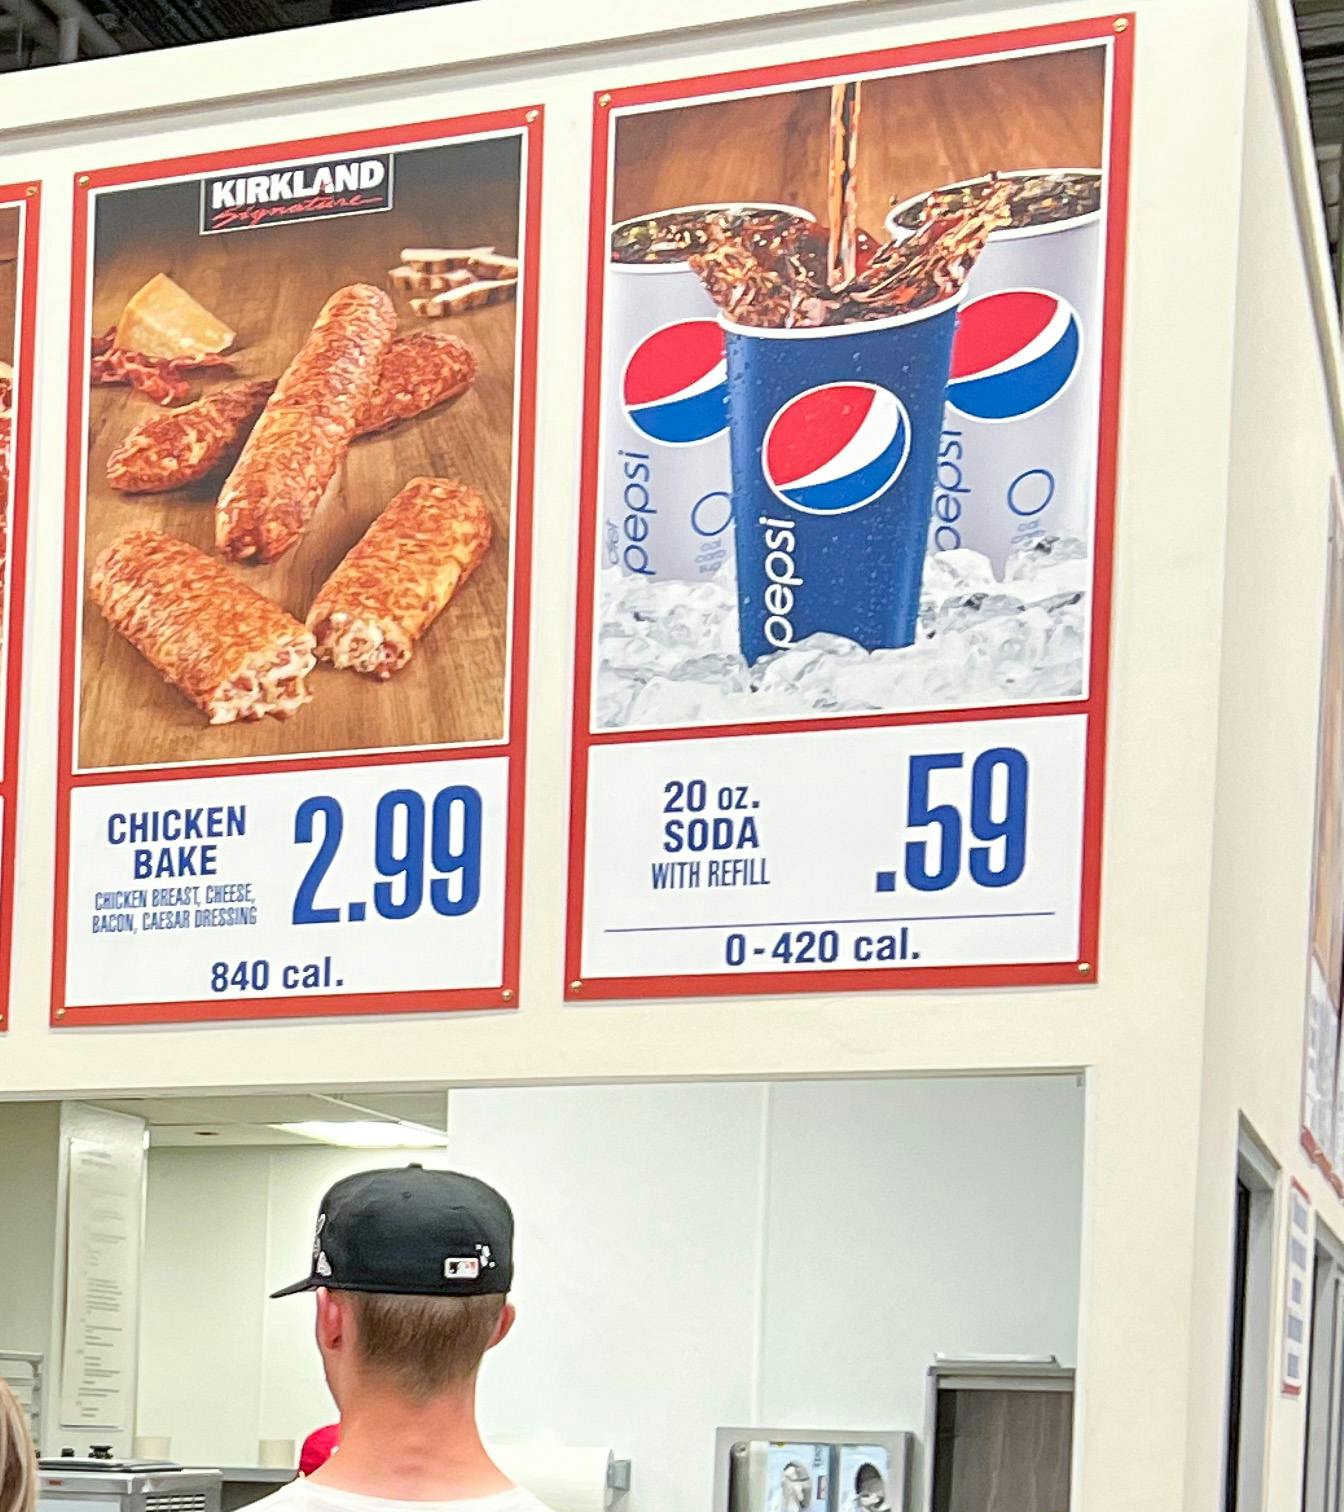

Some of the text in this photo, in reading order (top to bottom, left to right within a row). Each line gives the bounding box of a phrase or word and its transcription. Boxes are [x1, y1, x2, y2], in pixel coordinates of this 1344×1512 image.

[213, 160, 385, 209] KIRKLAND
[212, 194, 384, 229] Signature
[617, 449, 658, 575] pepsi
[760, 516, 803, 648] pepsi
[663, 779, 760, 813] 20 oz.
[107, 805, 247, 844] CHICKEN
[663, 816, 760, 852] SODA
[875, 747, 1029, 892] .59
[133, 844, 217, 879] BAKE
[291, 784, 483, 925] 2.99
[652, 858, 770, 889] WITH REFILL
[95, 883, 255, 911] CHICKEN BREAST, CHEESE,
[92, 906, 257, 934] BACON, CAESAR DRESSING
[853, 927, 920, 961] cal.
[211, 956, 344, 992] 840 cal.
